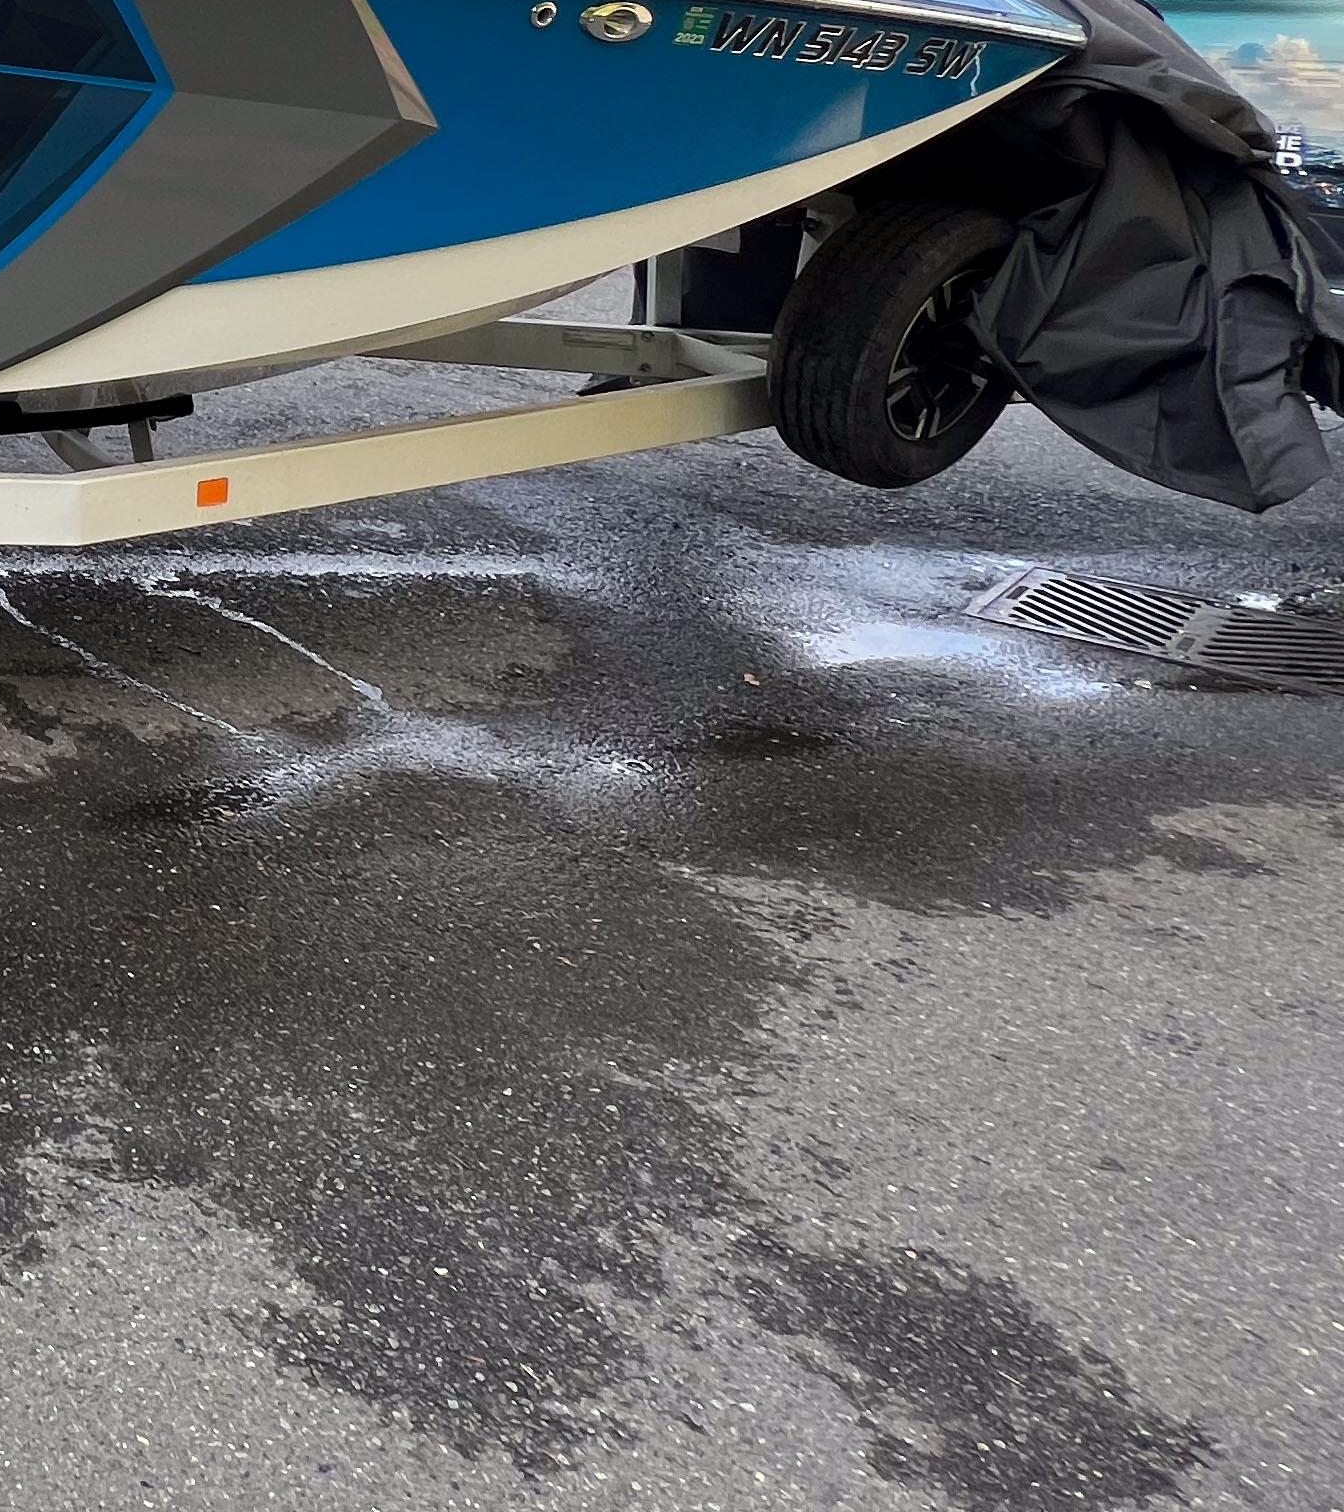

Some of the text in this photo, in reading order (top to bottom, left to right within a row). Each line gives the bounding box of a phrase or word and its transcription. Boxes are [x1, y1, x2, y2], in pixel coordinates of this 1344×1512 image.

[710, 10, 984, 80] WN 5143 SW
